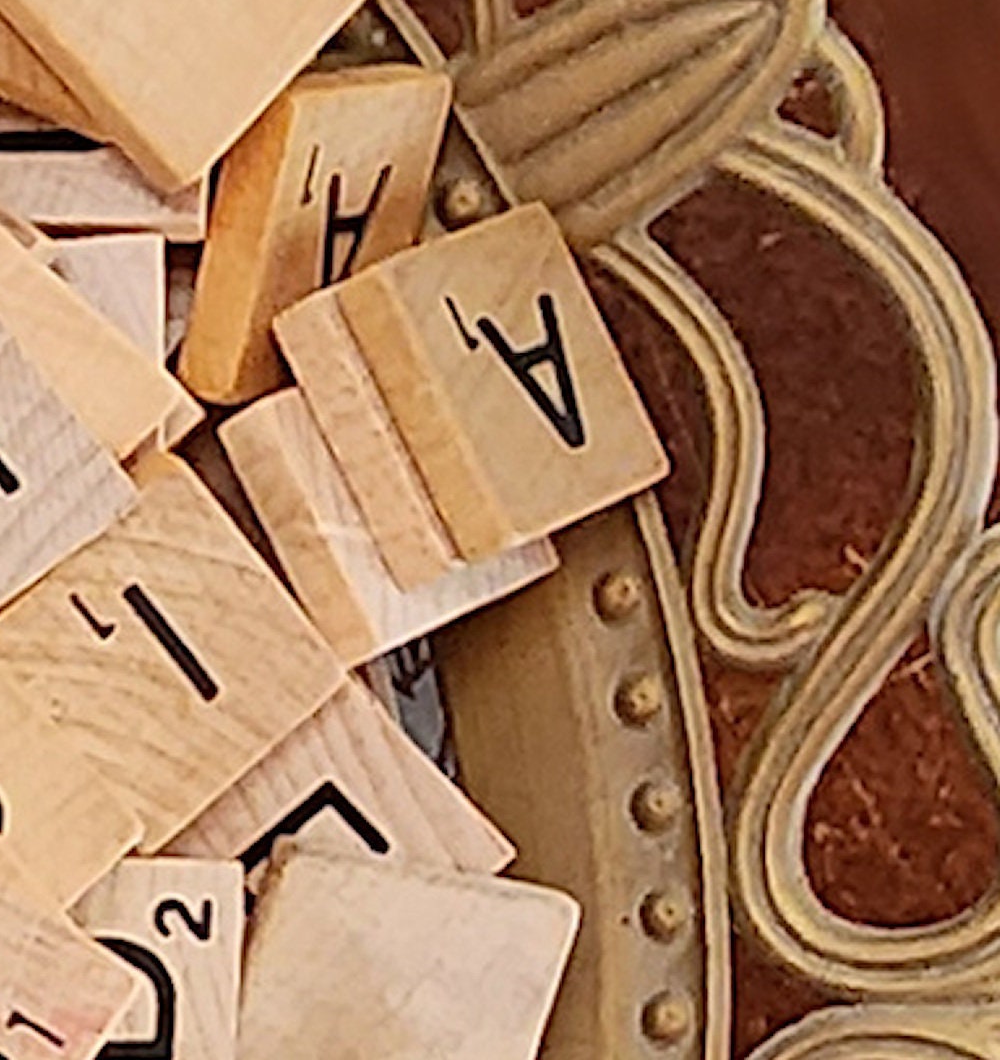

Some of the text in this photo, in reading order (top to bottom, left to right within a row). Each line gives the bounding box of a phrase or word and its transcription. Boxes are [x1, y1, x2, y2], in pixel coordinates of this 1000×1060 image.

[299, 146, 392, 288] A 1
[444, 294, 587, 449] A 1
[70, 584, 219, 702] I 1
[154, 899, 212, 941] 2
[6, 1011, 64, 1047] 1
